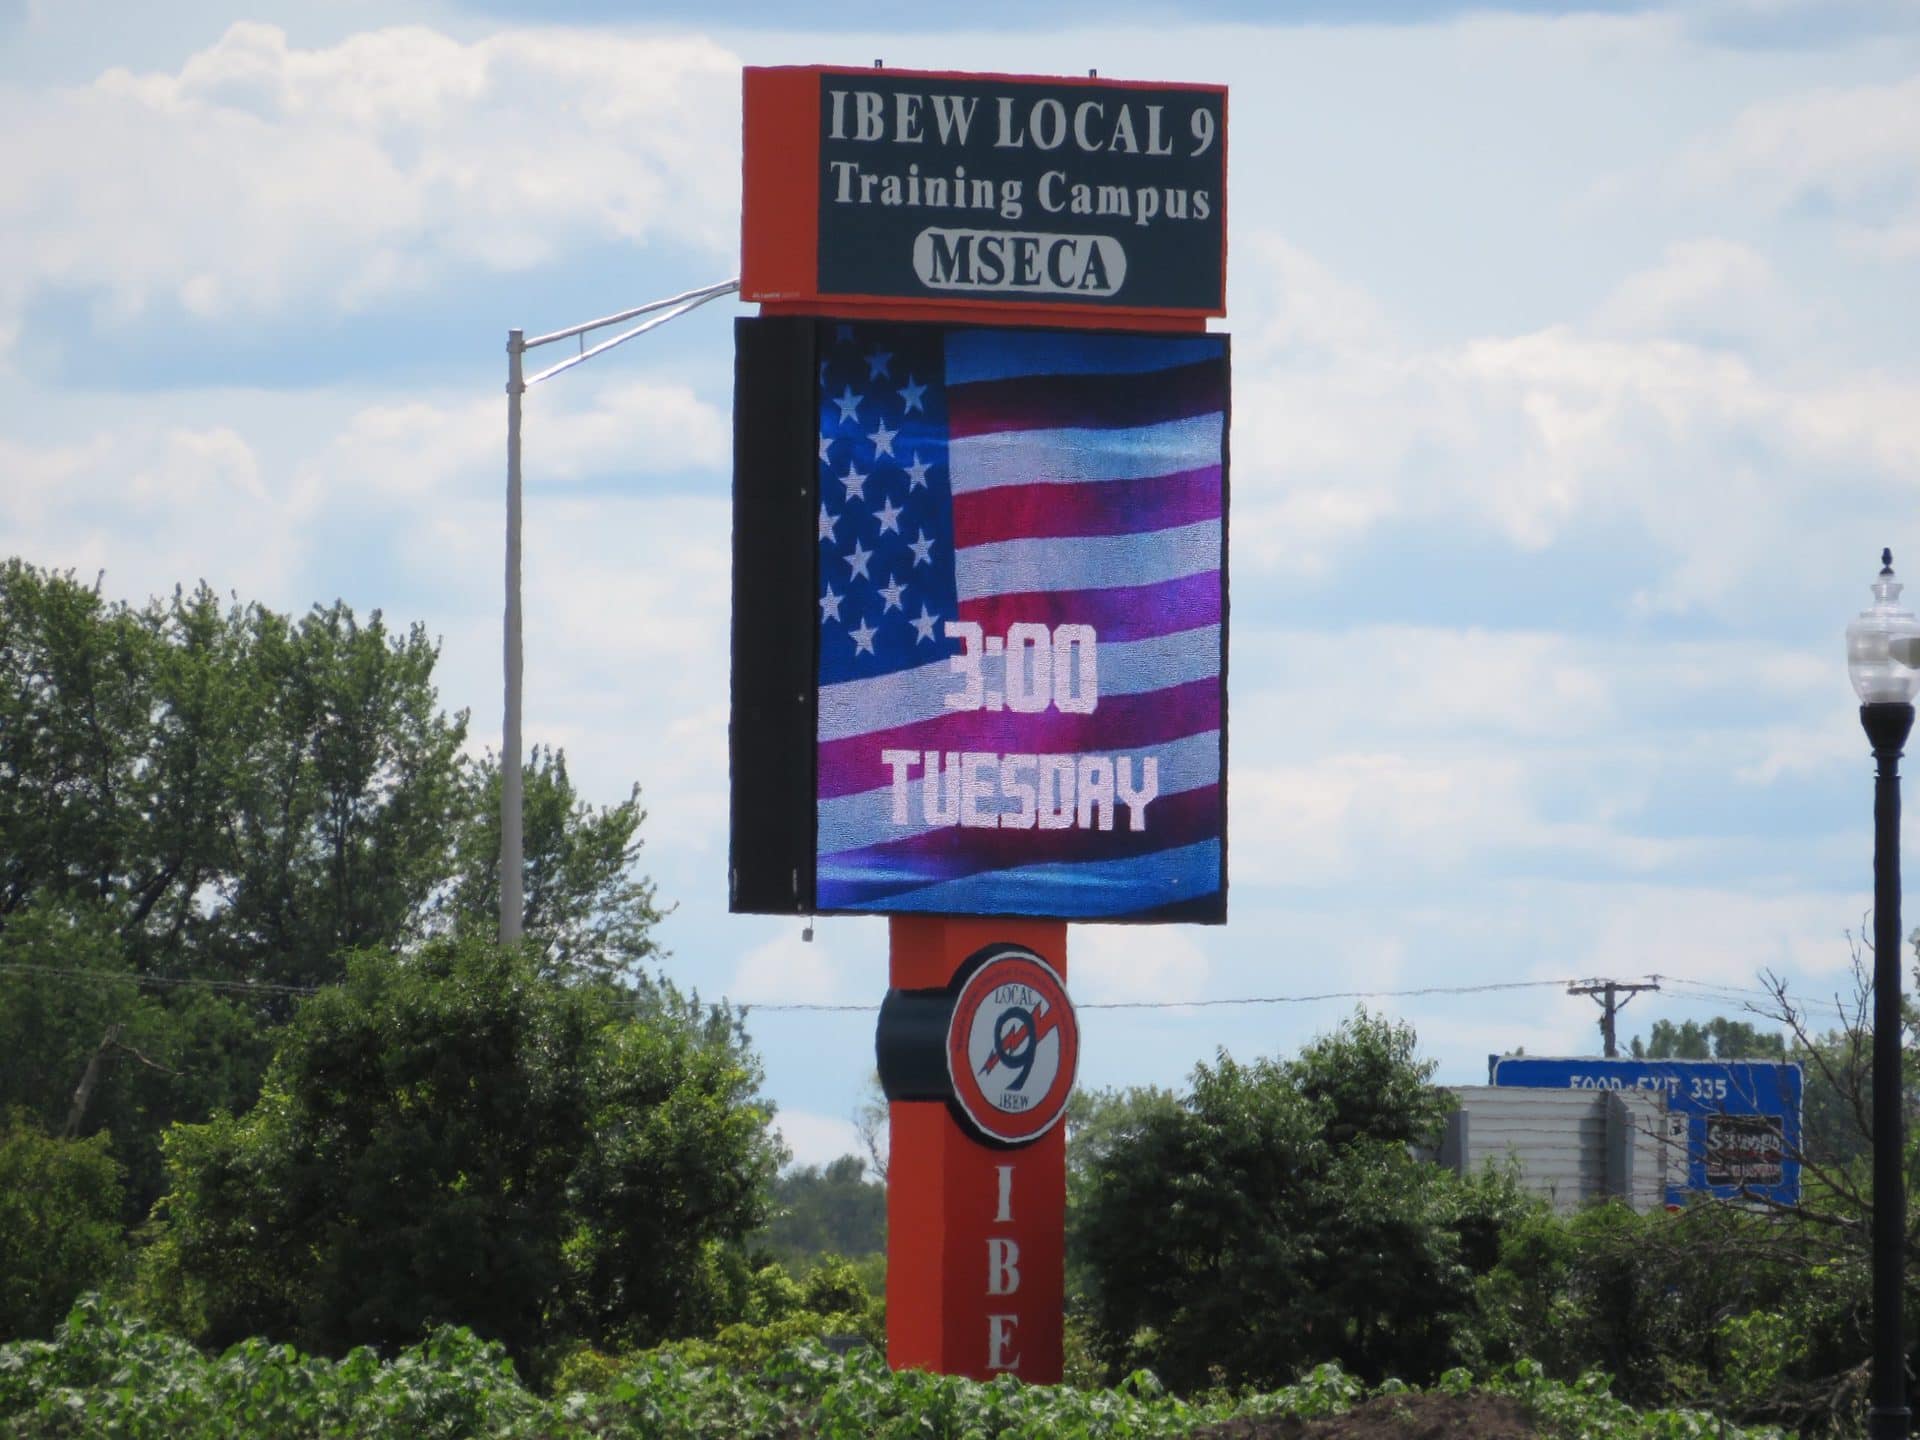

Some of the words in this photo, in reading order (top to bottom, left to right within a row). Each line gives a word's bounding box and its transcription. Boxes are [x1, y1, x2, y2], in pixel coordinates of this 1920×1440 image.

[828, 90, 979, 146] IBEW
[993, 97, 1173, 156] LOCAL
[1190, 107, 1215, 157] 9
[830, 161, 1023, 219] Training
[1038, 170, 1210, 225] Campus
[928, 233, 1111, 290] MSECA
[944, 621, 1098, 714] 3:00
[881, 749, 1158, 831] TUESDAY
[994, 985, 1037, 1006] LOCAL
[994, 1006, 1037, 1091] 9
[1691, 1078, 1728, 1099] 335
